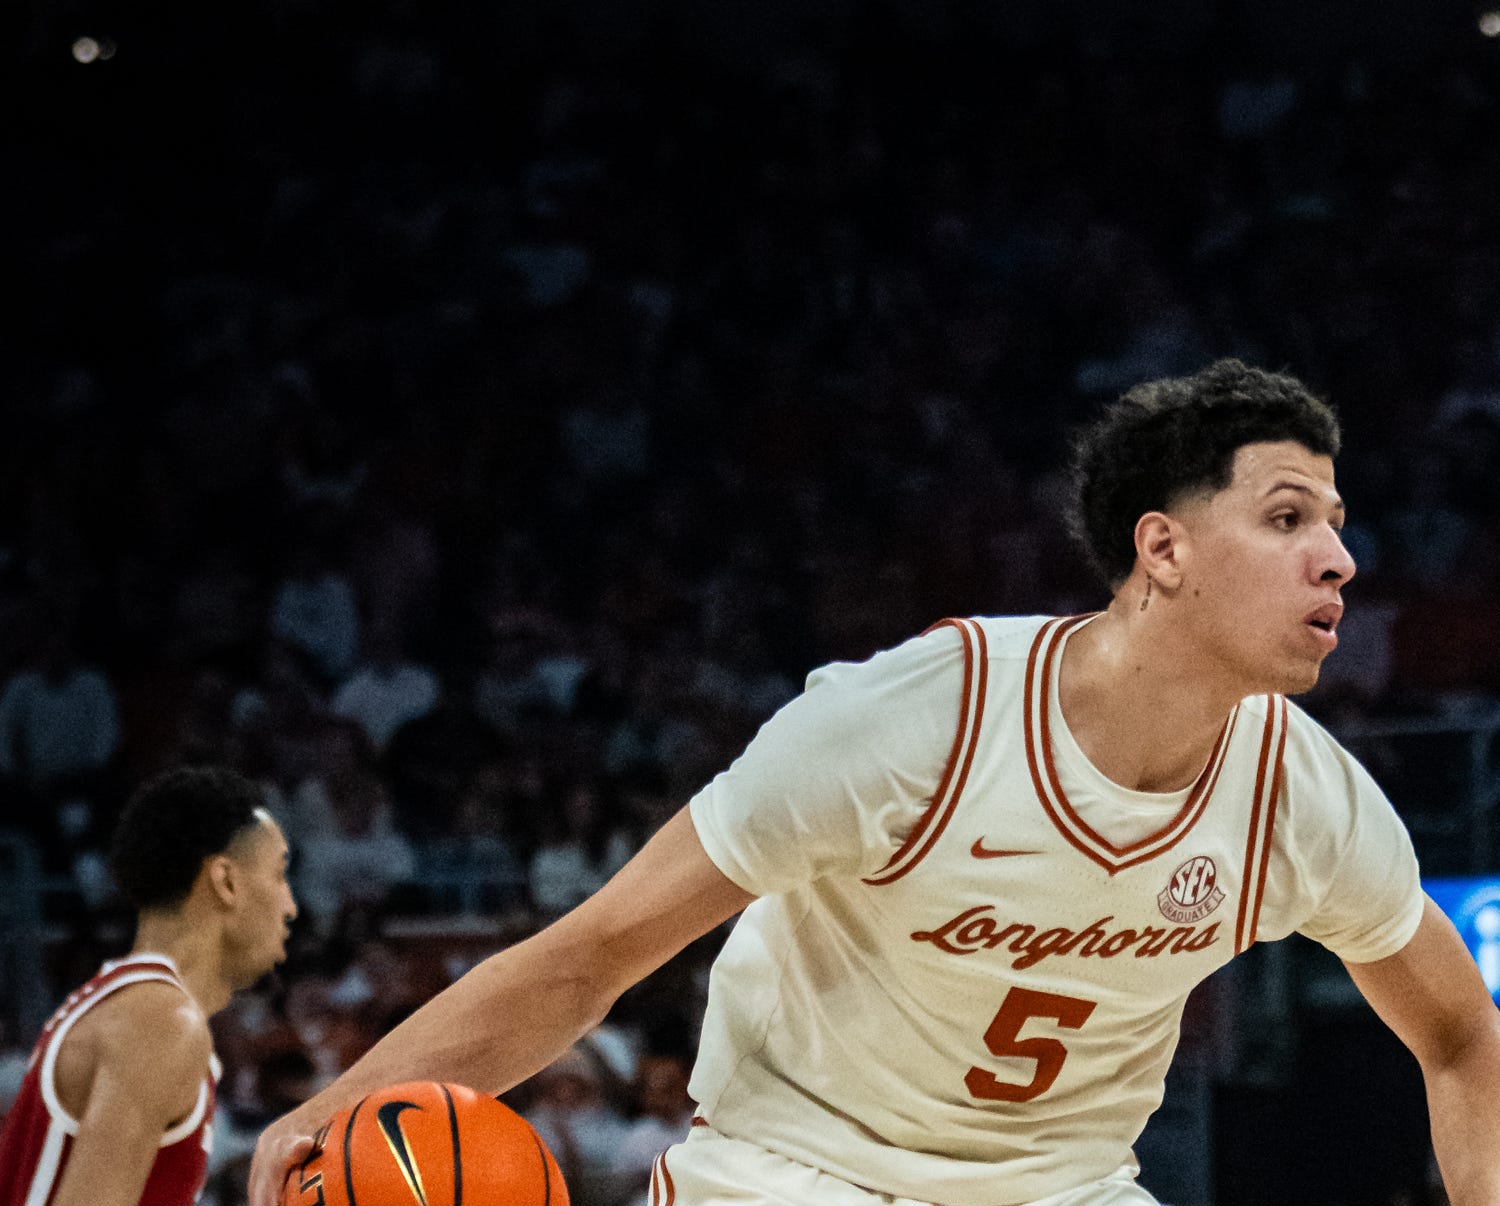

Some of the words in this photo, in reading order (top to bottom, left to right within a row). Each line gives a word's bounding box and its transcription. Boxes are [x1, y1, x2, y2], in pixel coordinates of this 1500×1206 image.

[1170, 858, 1215, 905] SEC
[910, 905, 1222, 970] Longhorns
[1162, 900, 1213, 920] GRADUATE
[964, 986, 1097, 1102] 5
